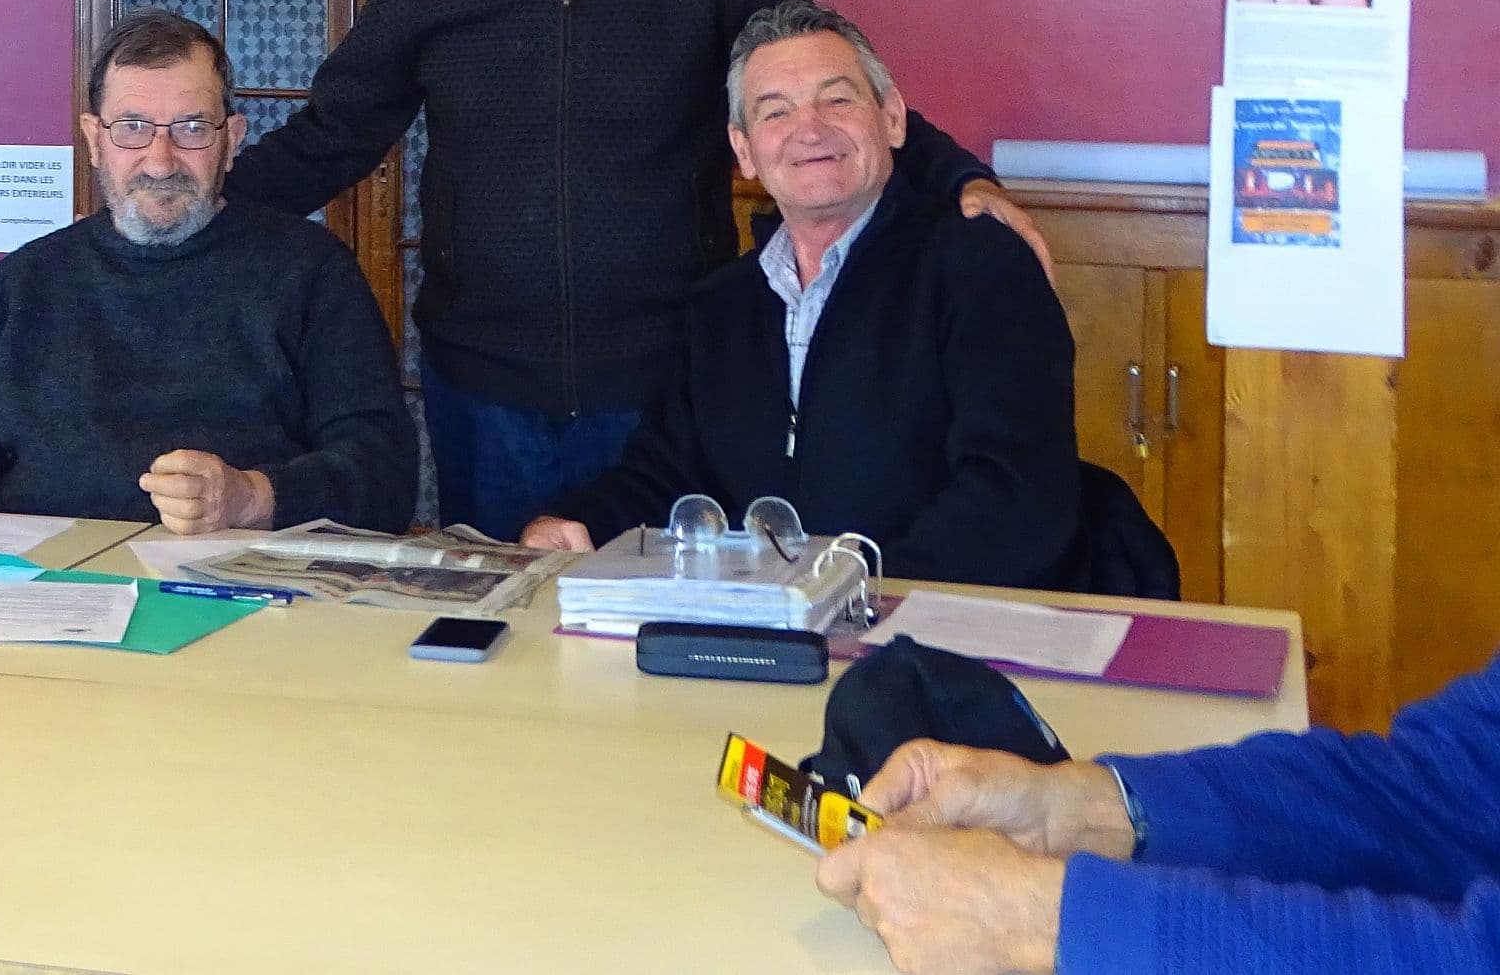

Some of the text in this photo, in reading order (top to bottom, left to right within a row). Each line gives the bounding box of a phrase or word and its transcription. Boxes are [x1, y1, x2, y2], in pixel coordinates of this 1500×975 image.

[19, 161, 46, 170] VIDER
[48, 162, 62, 170] LES
[13, 175, 38, 184] DANS
[40, 176, 54, 184] LES
